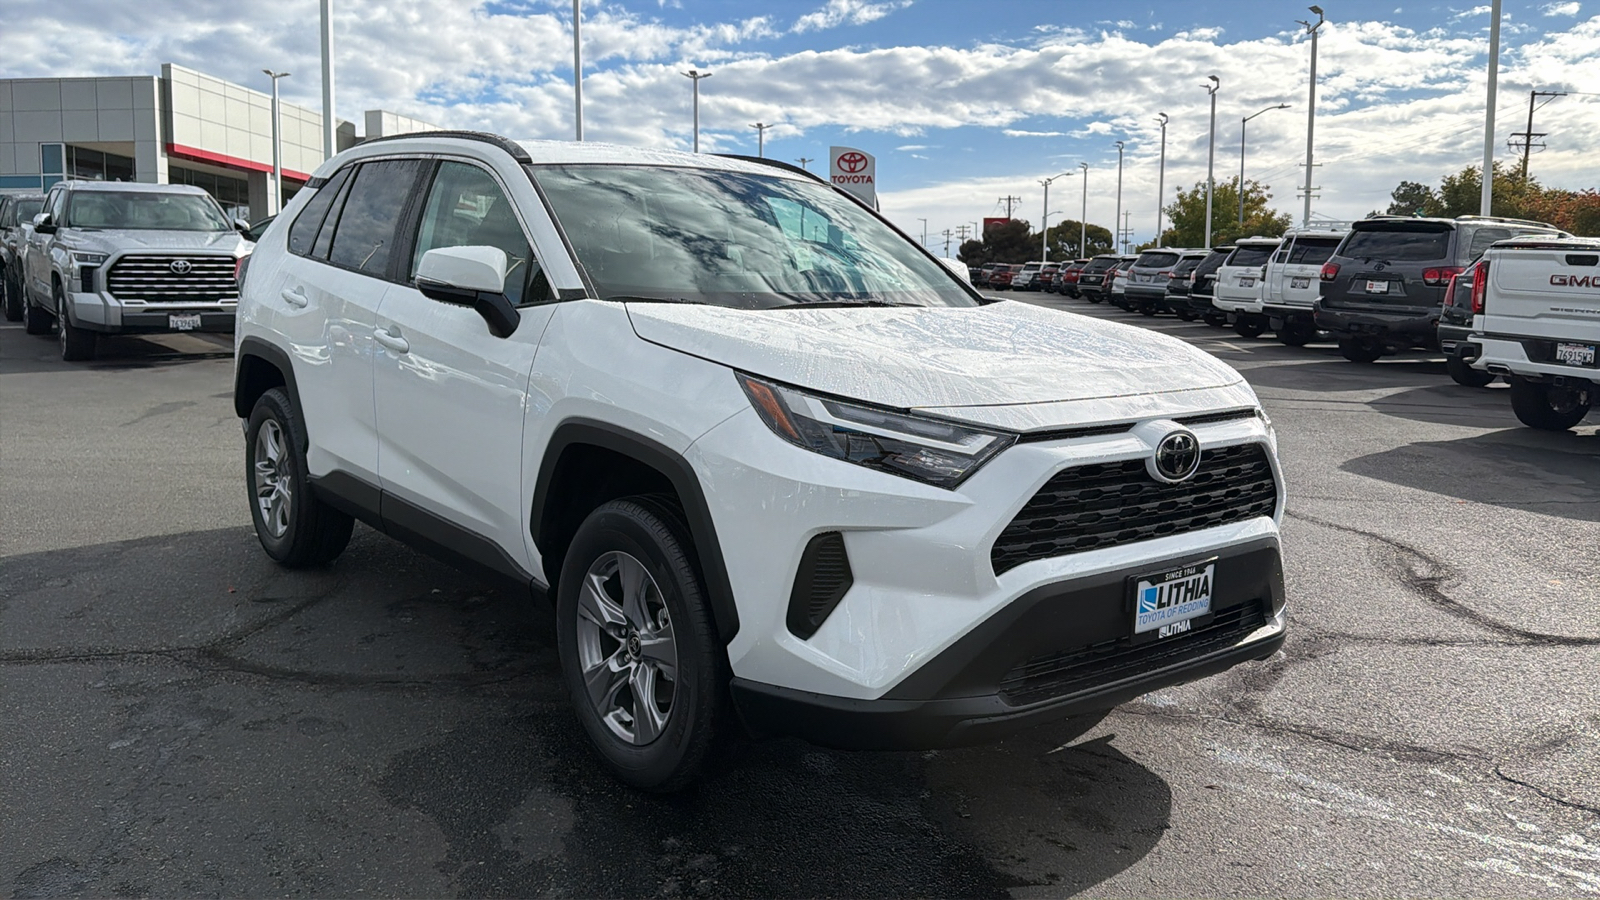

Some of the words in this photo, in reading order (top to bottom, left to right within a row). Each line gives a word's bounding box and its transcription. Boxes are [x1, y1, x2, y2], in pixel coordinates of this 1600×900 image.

[831, 175, 873, 184] TOYOTA
[1165, 570, 1183, 581] SINCE
[1157, 575, 1209, 610] LITHIA
[1138, 611, 1165, 626] TOYOTA
[1167, 606, 1177, 618] OF
[1177, 598, 1209, 615] REDDING
[1166, 619, 1191, 636] LITHIA
